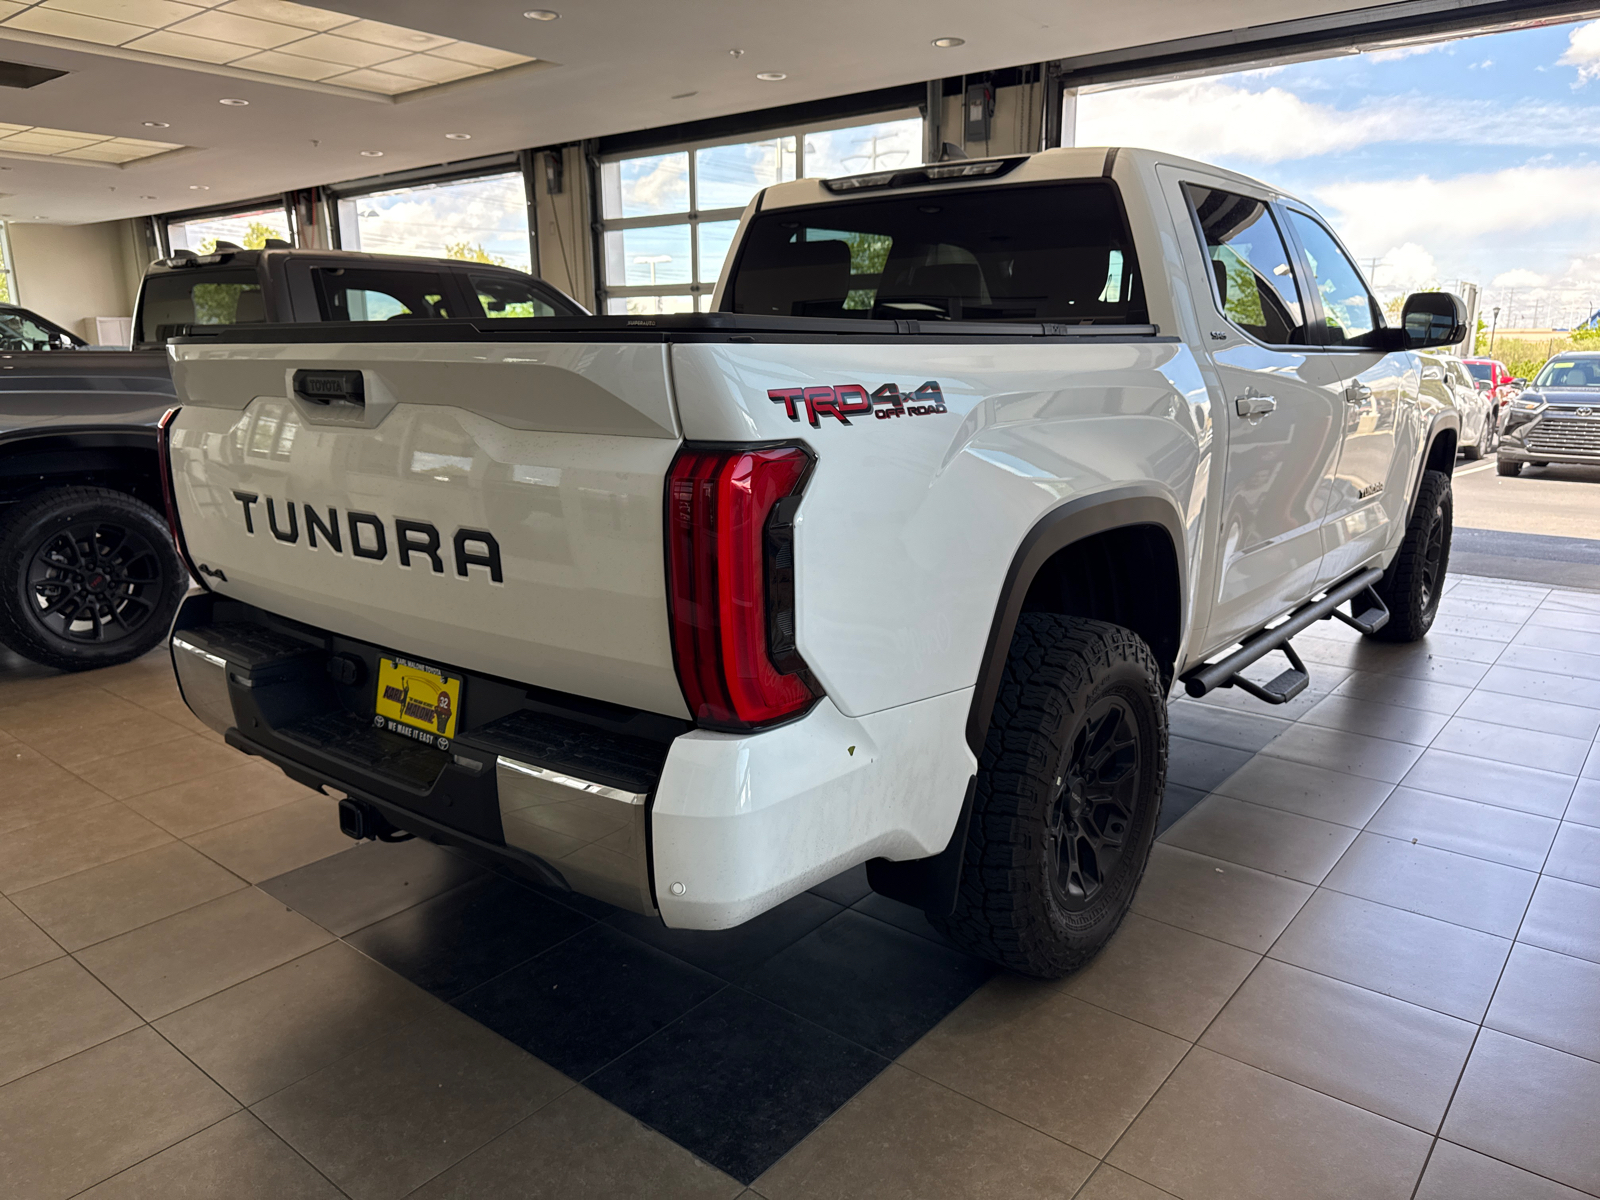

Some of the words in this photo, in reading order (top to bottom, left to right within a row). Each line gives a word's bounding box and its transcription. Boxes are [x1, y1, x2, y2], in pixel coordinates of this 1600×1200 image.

[309, 379, 342, 392] TOYOTA
[767, 384, 873, 429] TRD
[874, 406, 905, 420] OFF
[907, 404, 948, 417] ROAD
[232, 490, 503, 584] TUNDRA
[396, 657, 407, 667] KARL
[407, 660, 425, 671] MALONE
[426, 665, 441, 675] TOYOTA
[383, 685, 404, 704] KARL
[440, 697, 449, 709] 32
[404, 702, 436, 724] MALONE
[388, 721, 396, 732] WE
[397, 724, 412, 737] MAKE
[412, 729, 419, 739] IT
[420, 732, 433, 744] EASY
